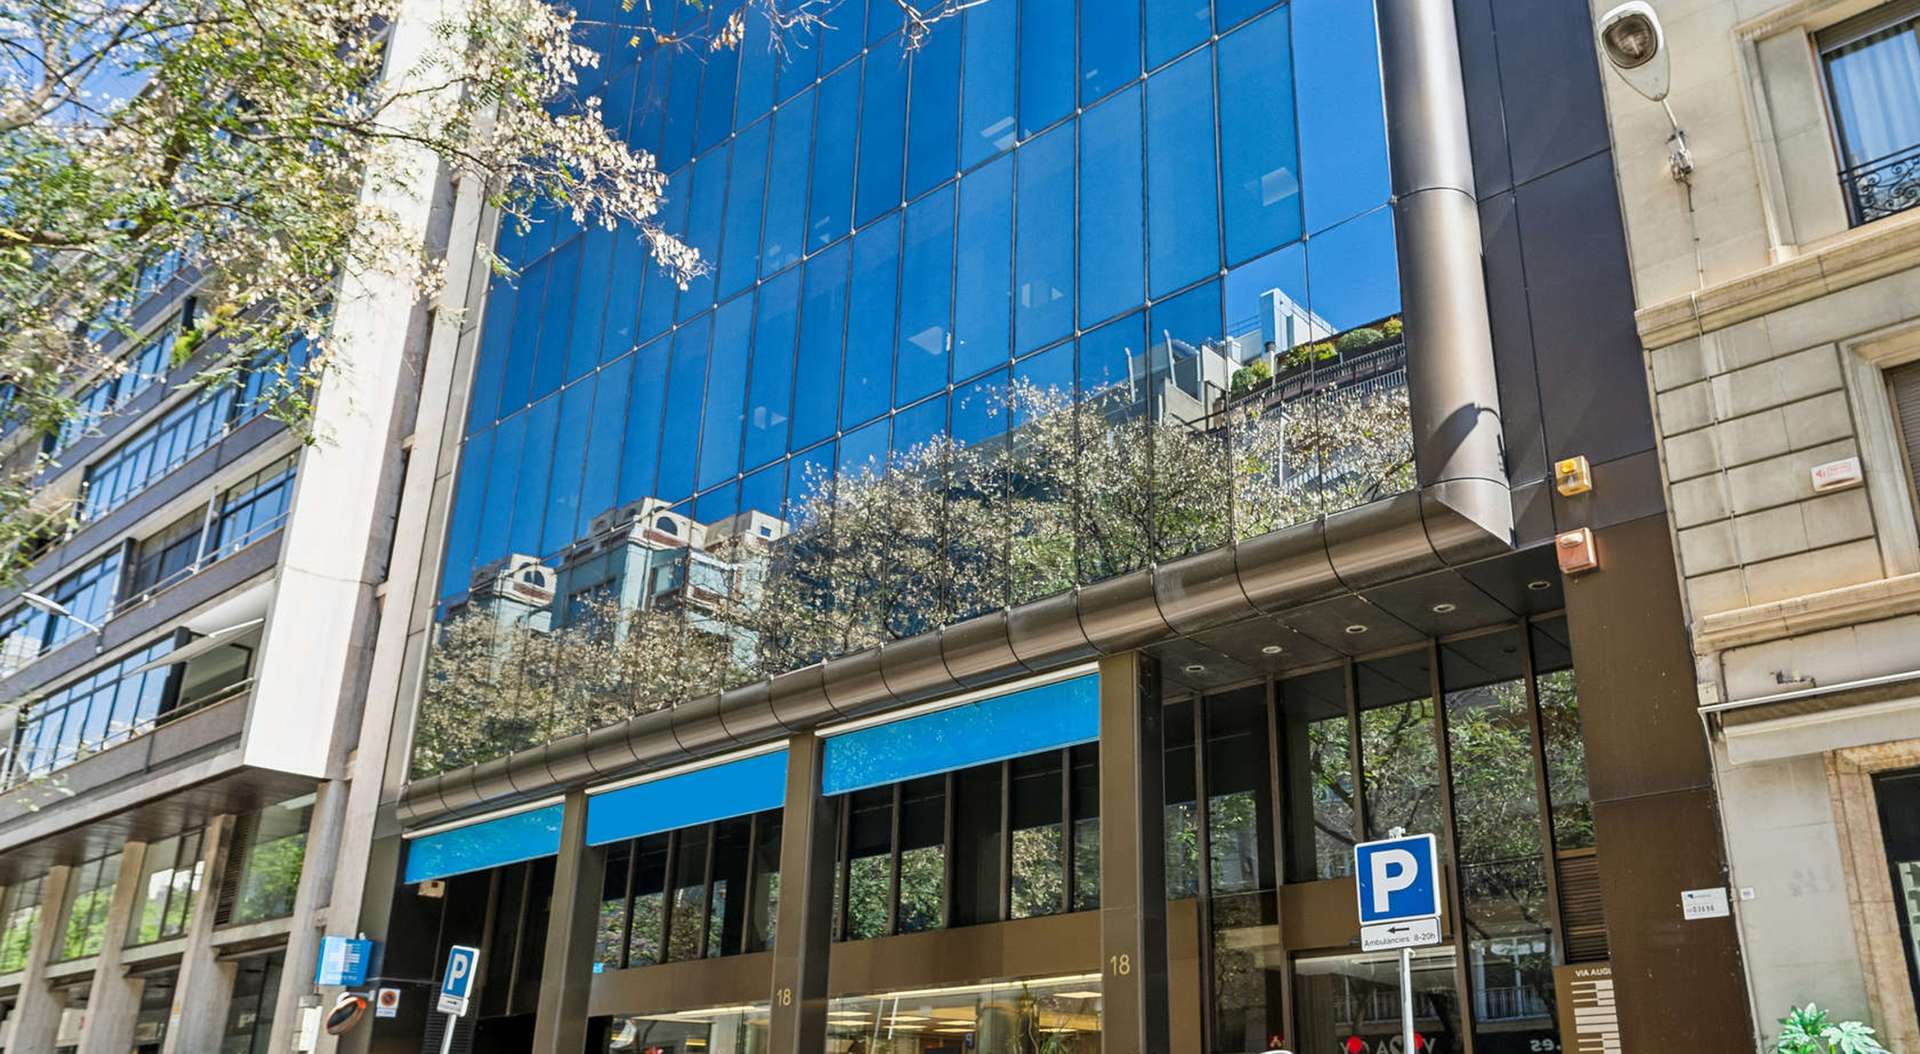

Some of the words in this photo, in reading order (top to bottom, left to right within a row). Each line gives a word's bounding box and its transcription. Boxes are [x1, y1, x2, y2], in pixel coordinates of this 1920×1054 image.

[1370, 849, 1418, 913] P
[447, 953, 468, 990] P
[1110, 954, 1130, 976] 18
[1575, 969, 1590, 977] VIA
[776, 988, 791, 1007] 18
